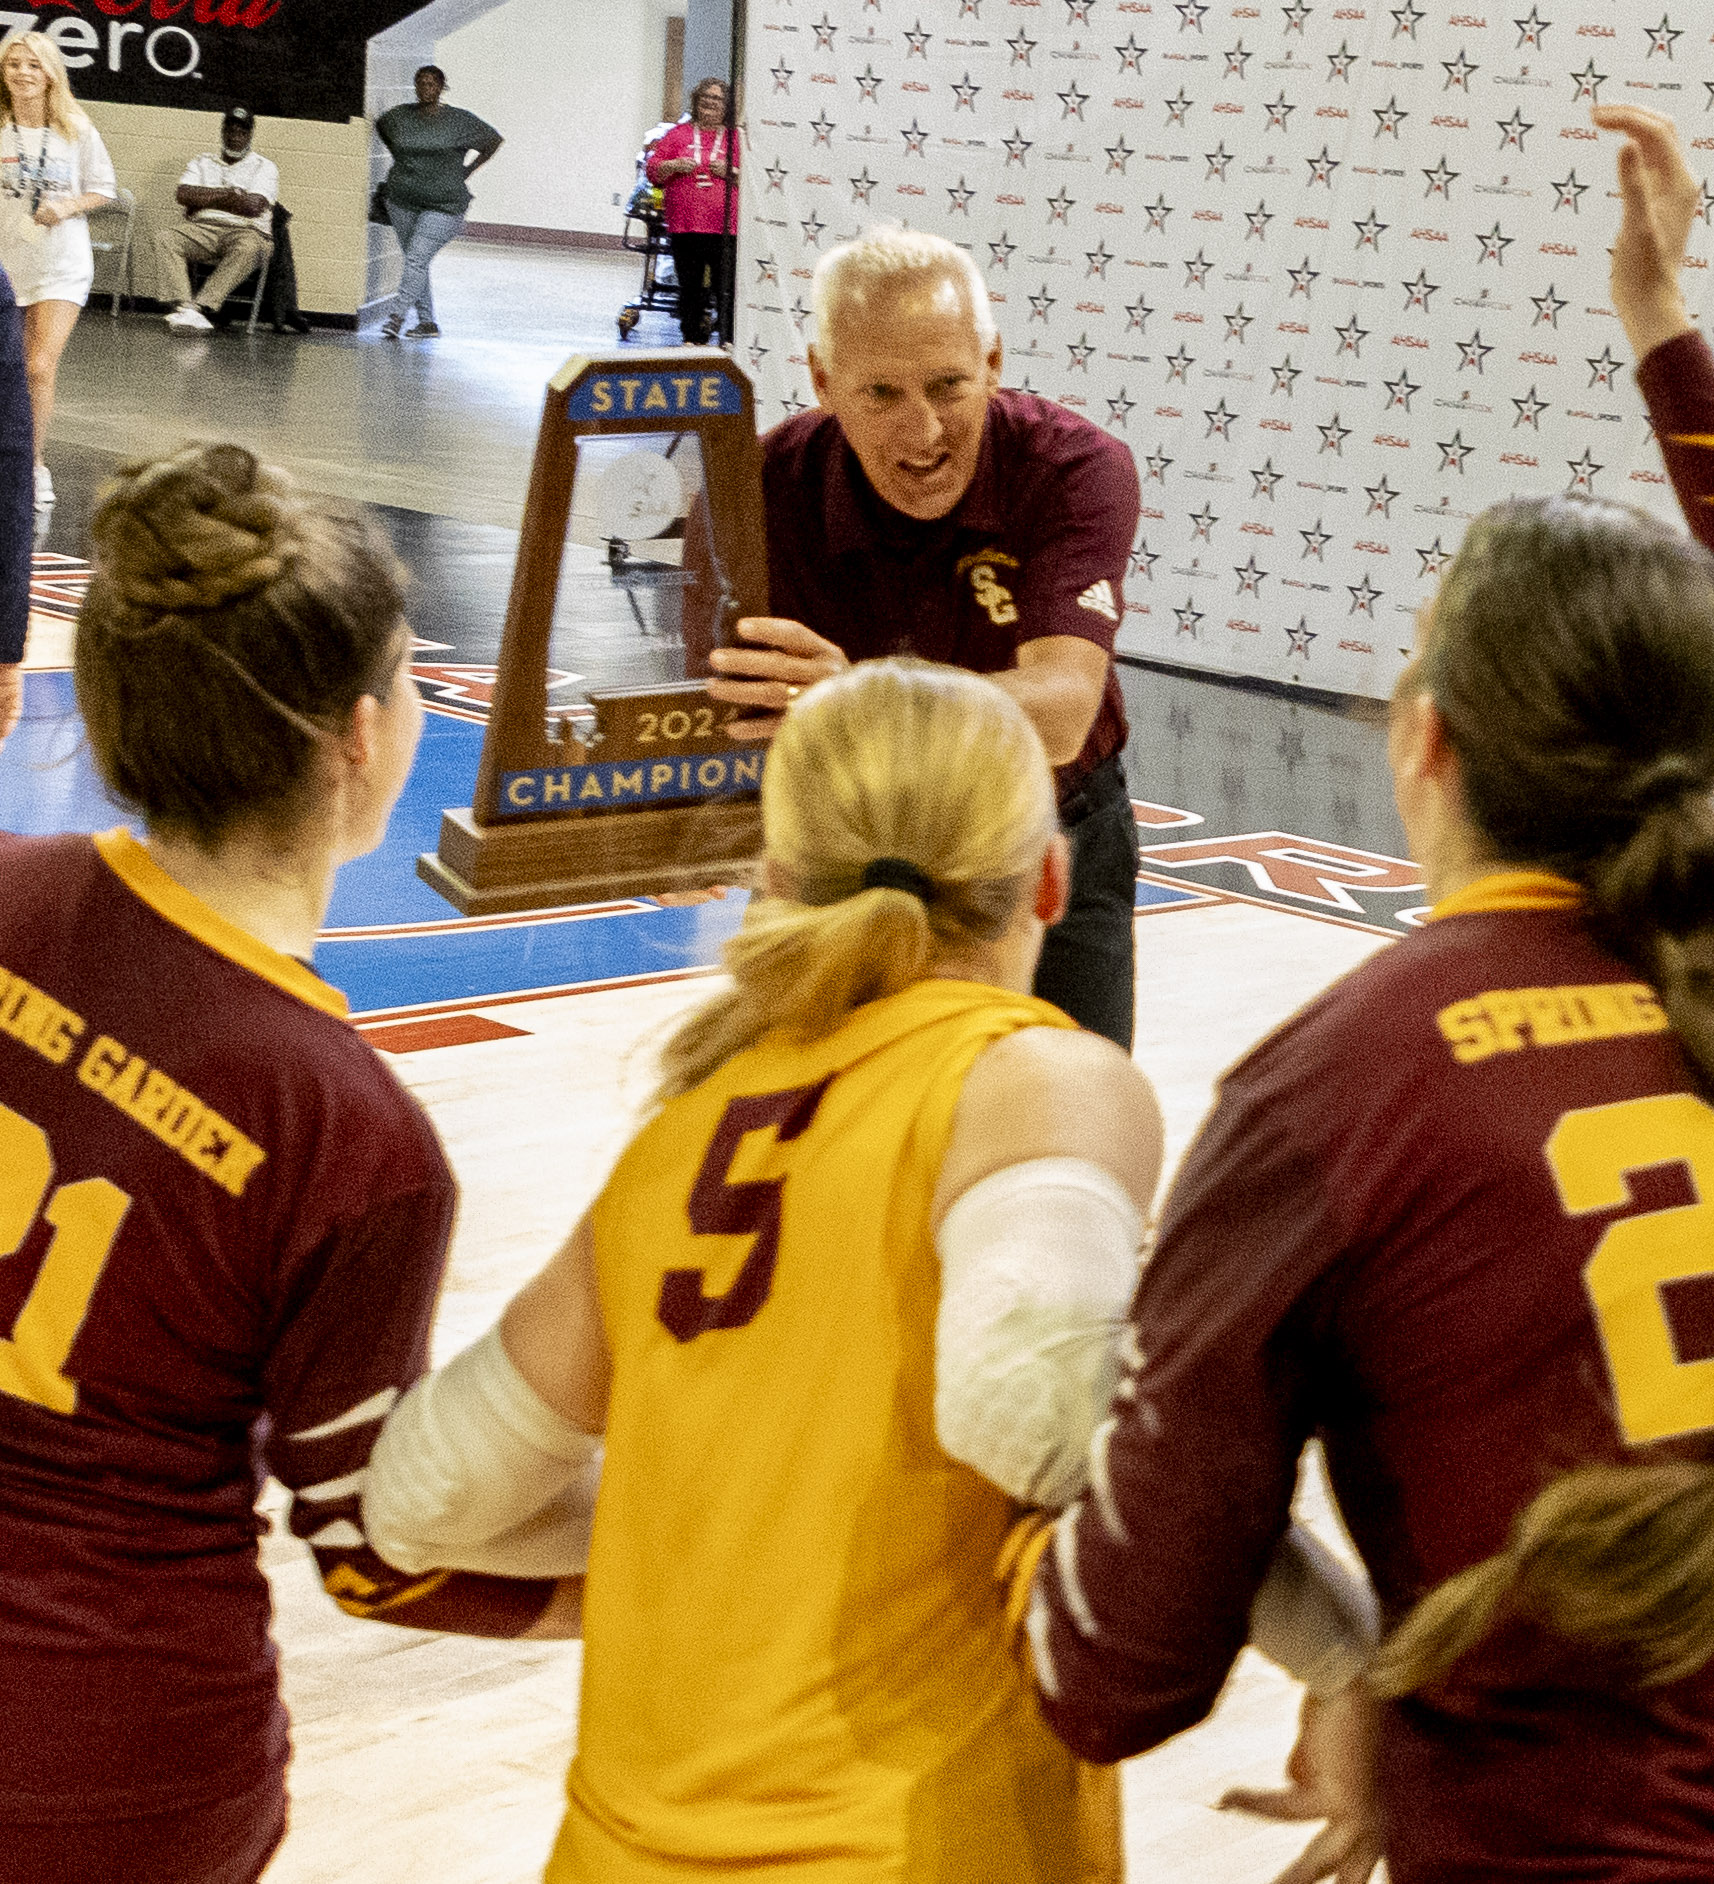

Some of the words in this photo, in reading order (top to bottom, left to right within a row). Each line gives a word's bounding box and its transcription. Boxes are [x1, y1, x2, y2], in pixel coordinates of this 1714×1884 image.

[590, 376, 723, 413] STATE
[1436, 982, 1669, 1064] SPRING
[77, 1033, 268, 1197] GARDEN
[655, 1069, 837, 1345] 5
